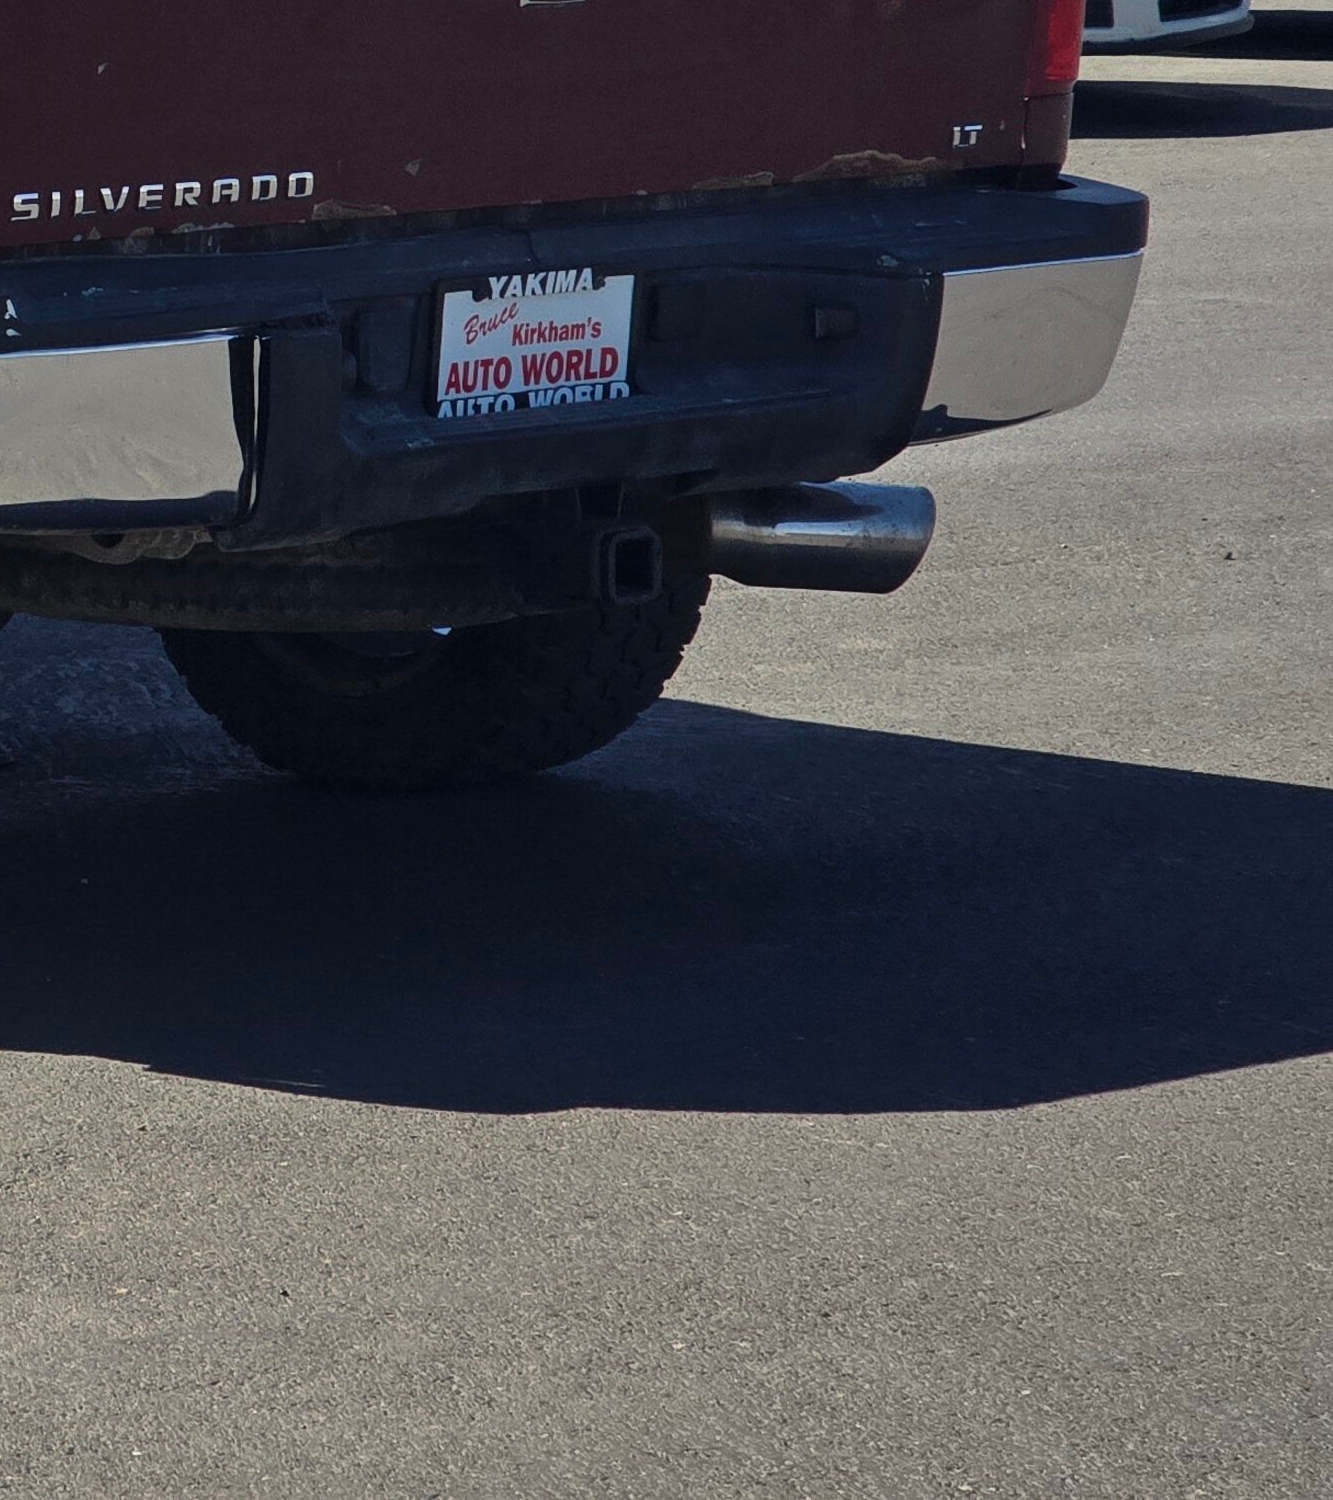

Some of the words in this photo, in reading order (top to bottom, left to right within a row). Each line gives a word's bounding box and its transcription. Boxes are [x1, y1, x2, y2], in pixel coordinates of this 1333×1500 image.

[953, 124, 983, 147] LT
[10, 171, 314, 222] SILVERADO
[487, 267, 594, 300] YAKIMA
[463, 301, 520, 345] Bruce
[511, 316, 603, 347] Kirkham's
[444, 355, 513, 396] AUTO
[521, 346, 620, 387] WORLD
